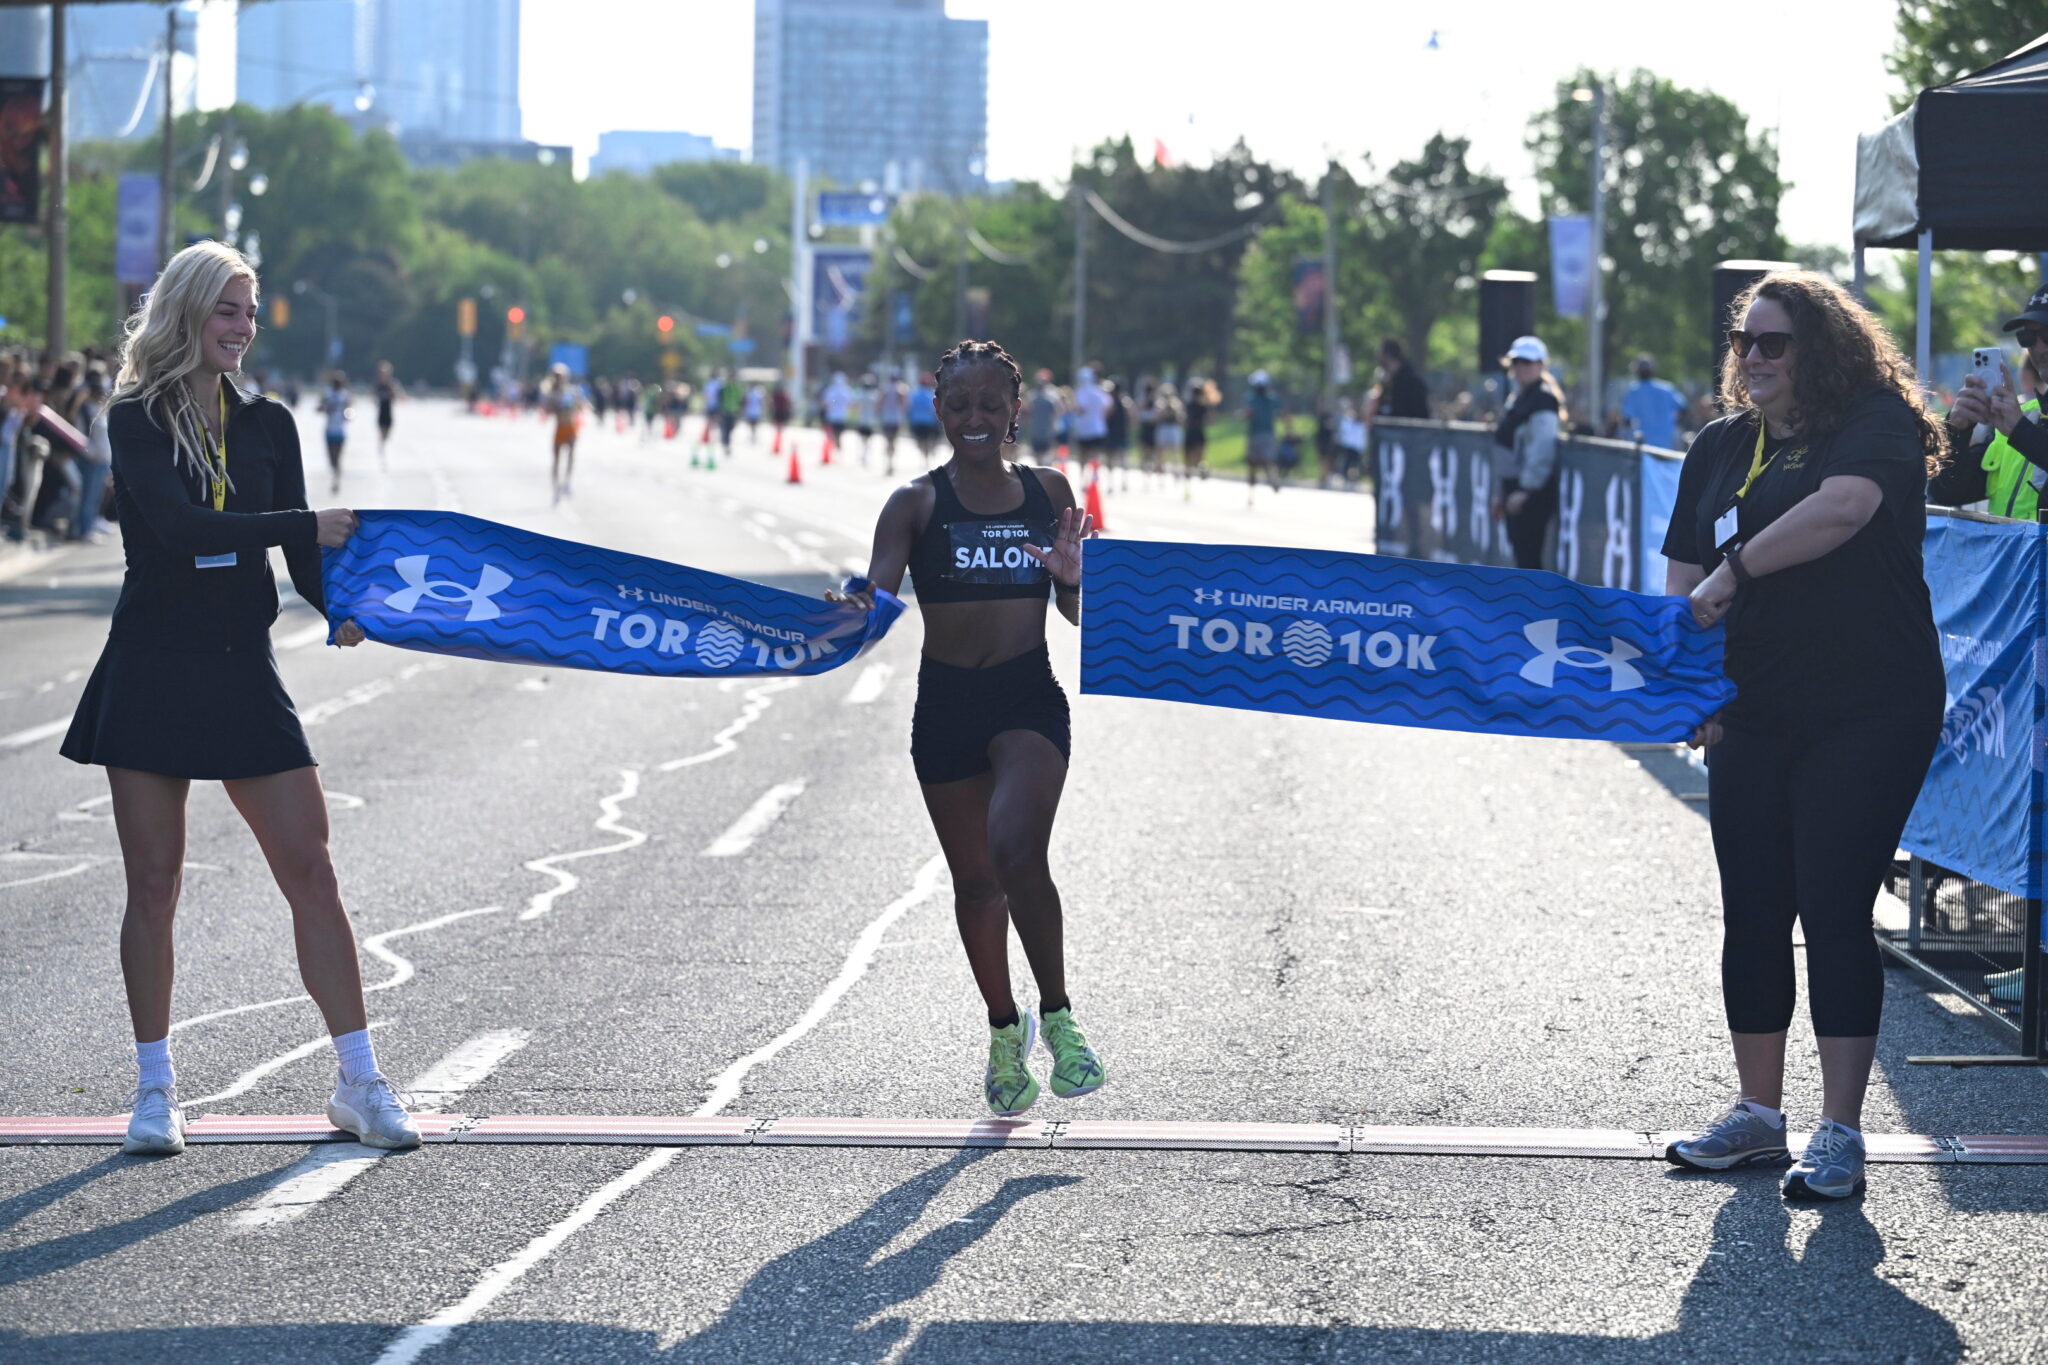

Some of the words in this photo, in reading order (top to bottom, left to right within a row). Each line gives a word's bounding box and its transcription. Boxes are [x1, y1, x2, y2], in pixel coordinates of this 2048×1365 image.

[981, 530, 1001, 538] TOR
[1012, 530, 1029, 538] 10K
[649, 591, 718, 615] UNDER
[722, 610, 805, 643] ARMOUR
[1230, 592, 1309, 612] UNDER
[1311, 599, 1413, 619] ARMOUR
[590, 607, 690, 655] TOR
[1169, 614, 1274, 657] TOR
[1340, 629, 1438, 671] 10K
